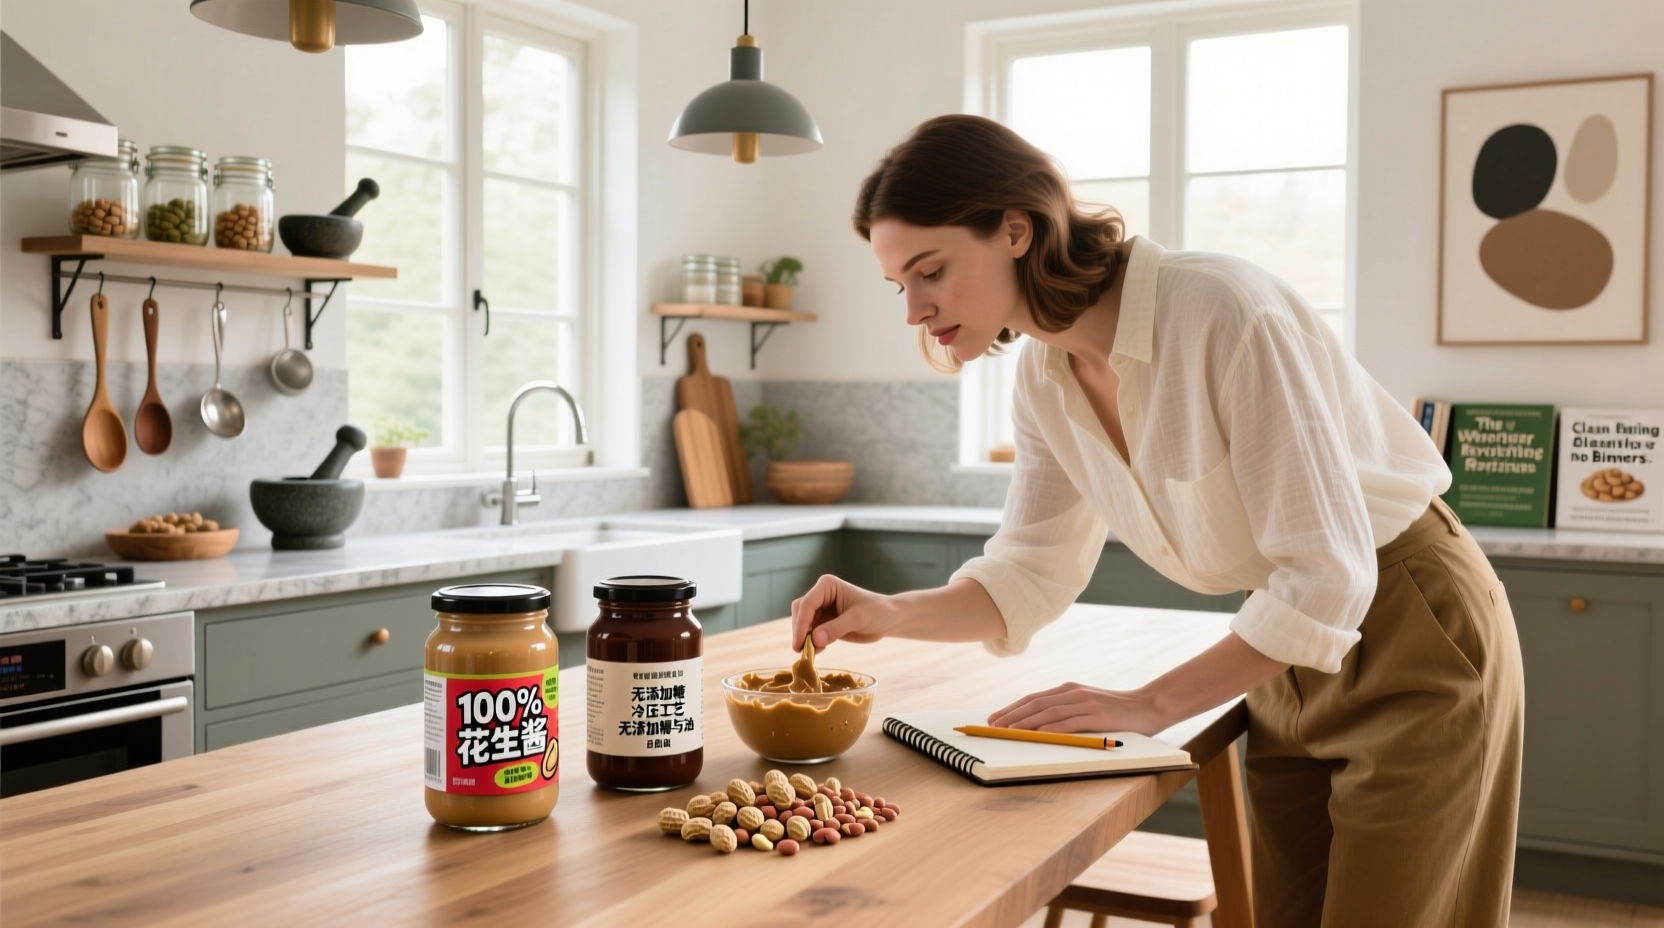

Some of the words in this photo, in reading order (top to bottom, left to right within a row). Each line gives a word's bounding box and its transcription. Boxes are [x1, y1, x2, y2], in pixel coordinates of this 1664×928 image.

[457, 686, 543, 726] 100%
[456, 717, 548, 766] 花生酱
